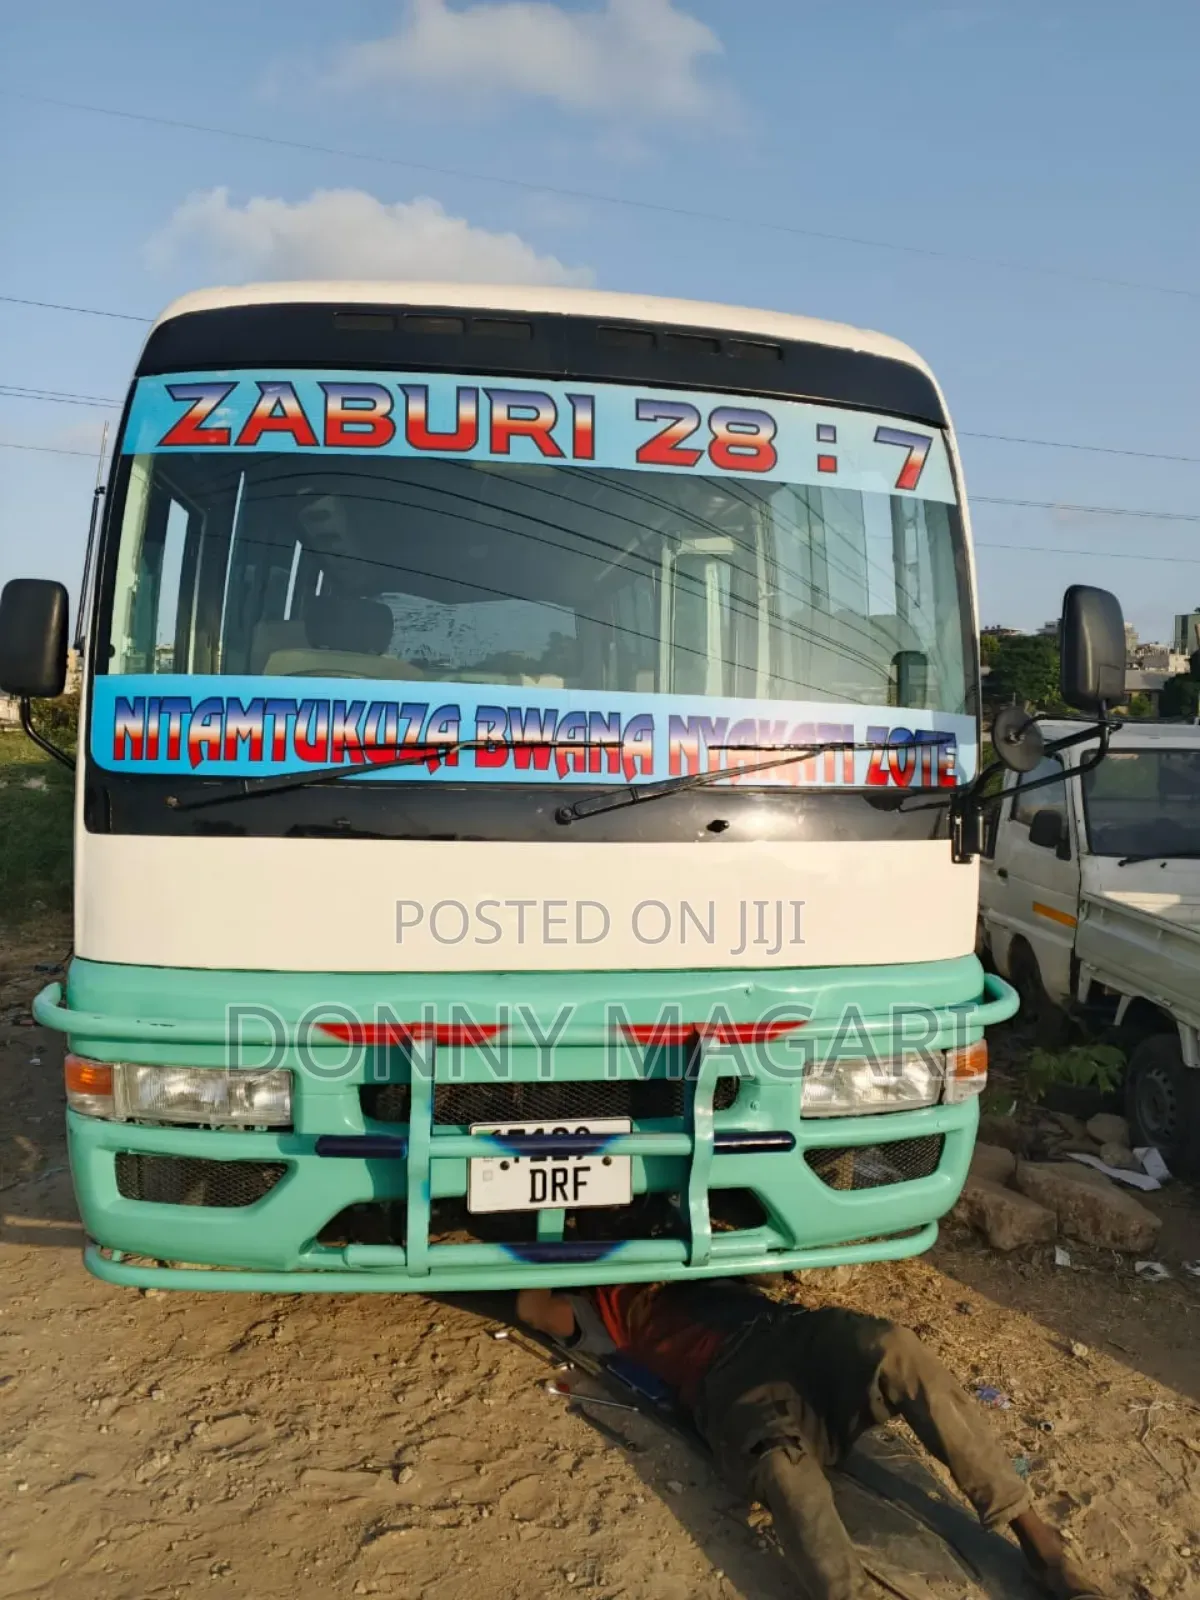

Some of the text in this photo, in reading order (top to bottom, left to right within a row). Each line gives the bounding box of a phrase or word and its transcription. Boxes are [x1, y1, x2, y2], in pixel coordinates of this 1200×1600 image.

[157, 380, 595, 460] ZABURI
[635, 398, 778, 473] 28
[873, 425, 933, 490] 7
[113, 696, 957, 788] NITAMTUKUZA BWANA NYAKATI ZOTE
[529, 1166, 591, 1203] DRF
